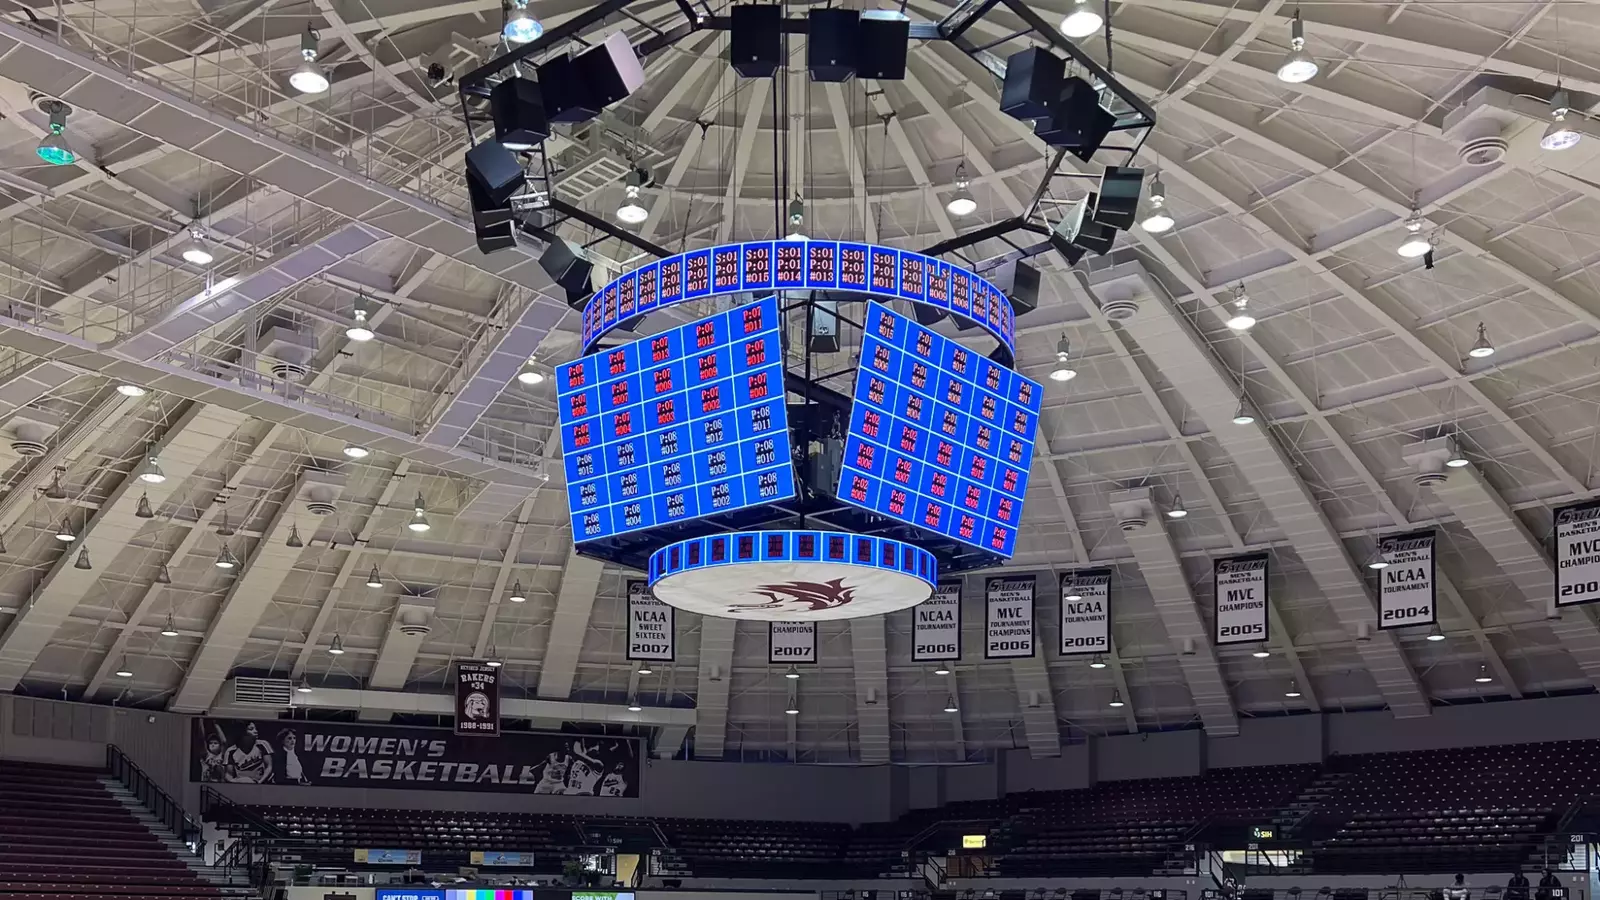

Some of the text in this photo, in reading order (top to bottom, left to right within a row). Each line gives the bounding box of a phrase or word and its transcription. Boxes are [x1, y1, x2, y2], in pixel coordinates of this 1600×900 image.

[716, 252, 737, 263] S:01
[746, 248, 769, 259] S:01
[778, 248, 801, 258] S:01
[810, 248, 833, 258] S:01
[842, 249, 864, 260] S:01
[873, 253, 894, 265] S:01
[688, 256, 708, 267] S:01
[746, 260, 769, 271] P:01
[778, 259, 801, 269] P:01
[810, 260, 833, 270] P:01
[842, 261, 864, 272] P:01
[902, 259, 922, 270] S:01
[662, 262, 680, 274] S:01
[688, 269, 708, 279] P:01
[716, 264, 737, 275] P:01
[873, 266, 894, 277] P:01
[662, 274, 680, 286] P:01
[716, 276, 737, 286] #016
[746, 272, 769, 282] #015
[778, 272, 801, 281] #014
[810, 272, 833, 281] #013
[842, 273, 864, 284] #012
[902, 270, 922, 282] P:01
[640, 281, 656, 294] P:01
[688, 280, 708, 291] #017
[873, 278, 894, 288] #011
[902, 282, 922, 294] #010
[662, 285, 680, 298] #018
[743, 305, 762, 320] P:07
[879, 311, 895, 327] P:01
[695, 321, 713, 336] P:07
[744, 319, 763, 334] #011
[651, 336, 668, 350] P:07
[745, 339, 764, 354] P:07
[748, 373, 767, 387] P:07
[750, 406, 769, 420] P:08
[864, 410, 880, 425] P:02
[703, 419, 721, 432] P:08
[752, 419, 771, 433] #011
[659, 431, 676, 444] P:08
[704, 431, 723, 445] #012
[616, 442, 633, 455] P:08
[660, 443, 677, 456] #013
[754, 439, 773, 453] P:08
[576, 453, 592, 465] P:08
[618, 454, 634, 467] #014
[707, 451, 725, 464] P:08
[755, 452, 774, 465] #010
[577, 465, 593, 477] #015
[662, 462, 679, 475] P:08
[708, 463, 726, 476] #009
[620, 473, 636, 485] P:08
[663, 474, 681, 487] #008
[758, 472, 777, 485] P:08
[580, 483, 595, 495] P:08
[621, 485, 637, 497] #007
[711, 483, 729, 495] P:08
[759, 485, 778, 498] #001
[581, 494, 596, 506] #006
[666, 493, 683, 505] P:08
[712, 495, 730, 508] #002
[624, 503, 640, 515] P:08
[667, 505, 684, 517] #003
[583, 512, 599, 524] P:08
[625, 515, 641, 526] #004
[1573, 519, 1597, 529] MEN'S
[585, 524, 600, 535] #005
[1386, 555, 1430, 564] ASKETBALL
[1219, 576, 1262, 585] BASKETBALL
[1387, 568, 1425, 584] NCAA
[1384, 582, 1429, 593] TOURNAMENT
[1562, 581, 1600, 596] 200
[1227, 588, 1254, 602] MVC
[1068, 602, 1102, 614] NCAA
[1219, 601, 1263, 612] CHAMPIONS
[635, 611, 666, 622] NCAA
[920, 610, 953, 622] NCAA
[997, 608, 1023, 619] MVC
[1065, 615, 1105, 623] TOURNAMENT
[1384, 606, 1429, 620] 2004
[773, 626, 812, 634] CHAMPIONS
[989, 628, 1030, 636] CHAMPIONS
[1221, 624, 1262, 636] 2005
[990, 641, 1029, 650] 2006
[1065, 637, 1105, 647] 2005
[632, 644, 669, 653] 2007
[774, 647, 811, 656] 2007
[917, 644, 955, 653] 2006
[461, 673, 495, 684] RAKERS
[461, 722, 494, 730] 1988-1991
[303, 734, 447, 757] WOMEN'S
[320, 757, 536, 785] BASKETBALL
[1552, 889, 1563, 897] 101
